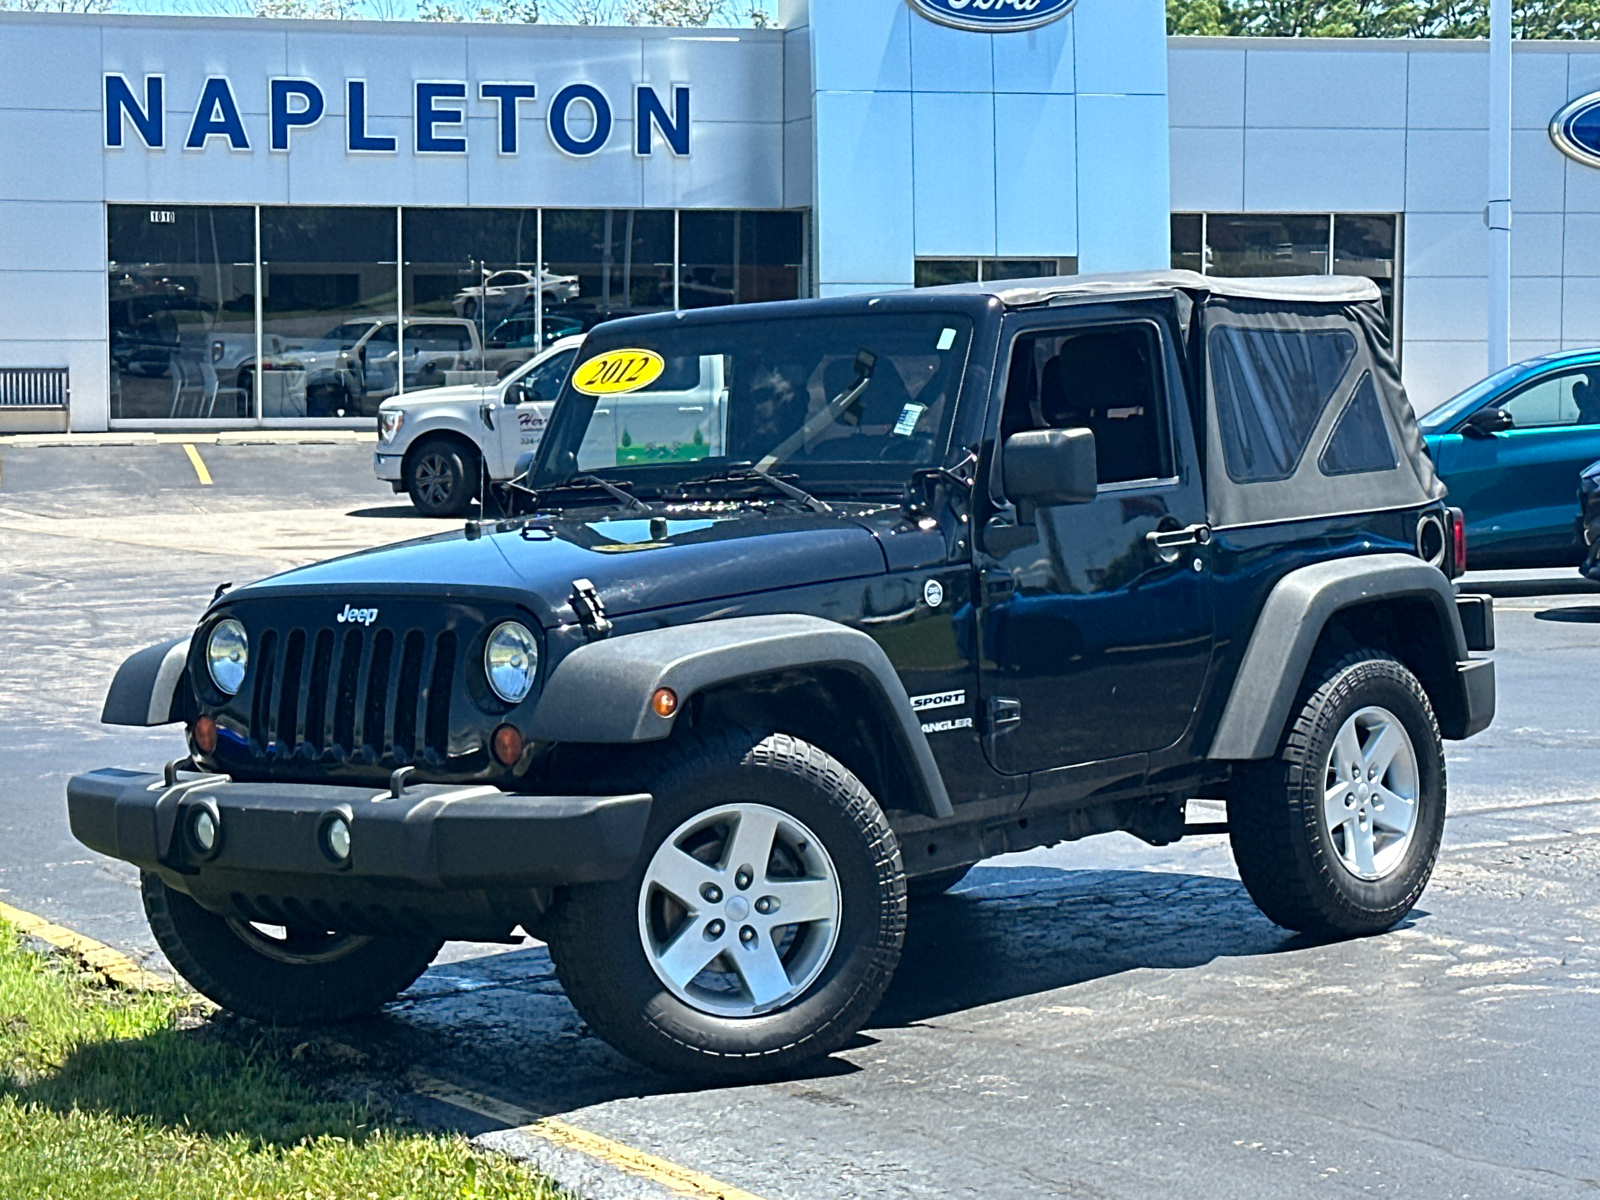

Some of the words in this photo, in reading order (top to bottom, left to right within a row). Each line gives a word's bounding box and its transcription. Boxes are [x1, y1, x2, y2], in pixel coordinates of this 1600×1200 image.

[103, 72, 692, 157] NAPLETON
[585, 357, 649, 385] 2012
[336, 603, 379, 627] Jeep
[914, 694, 960, 706] SPORT
